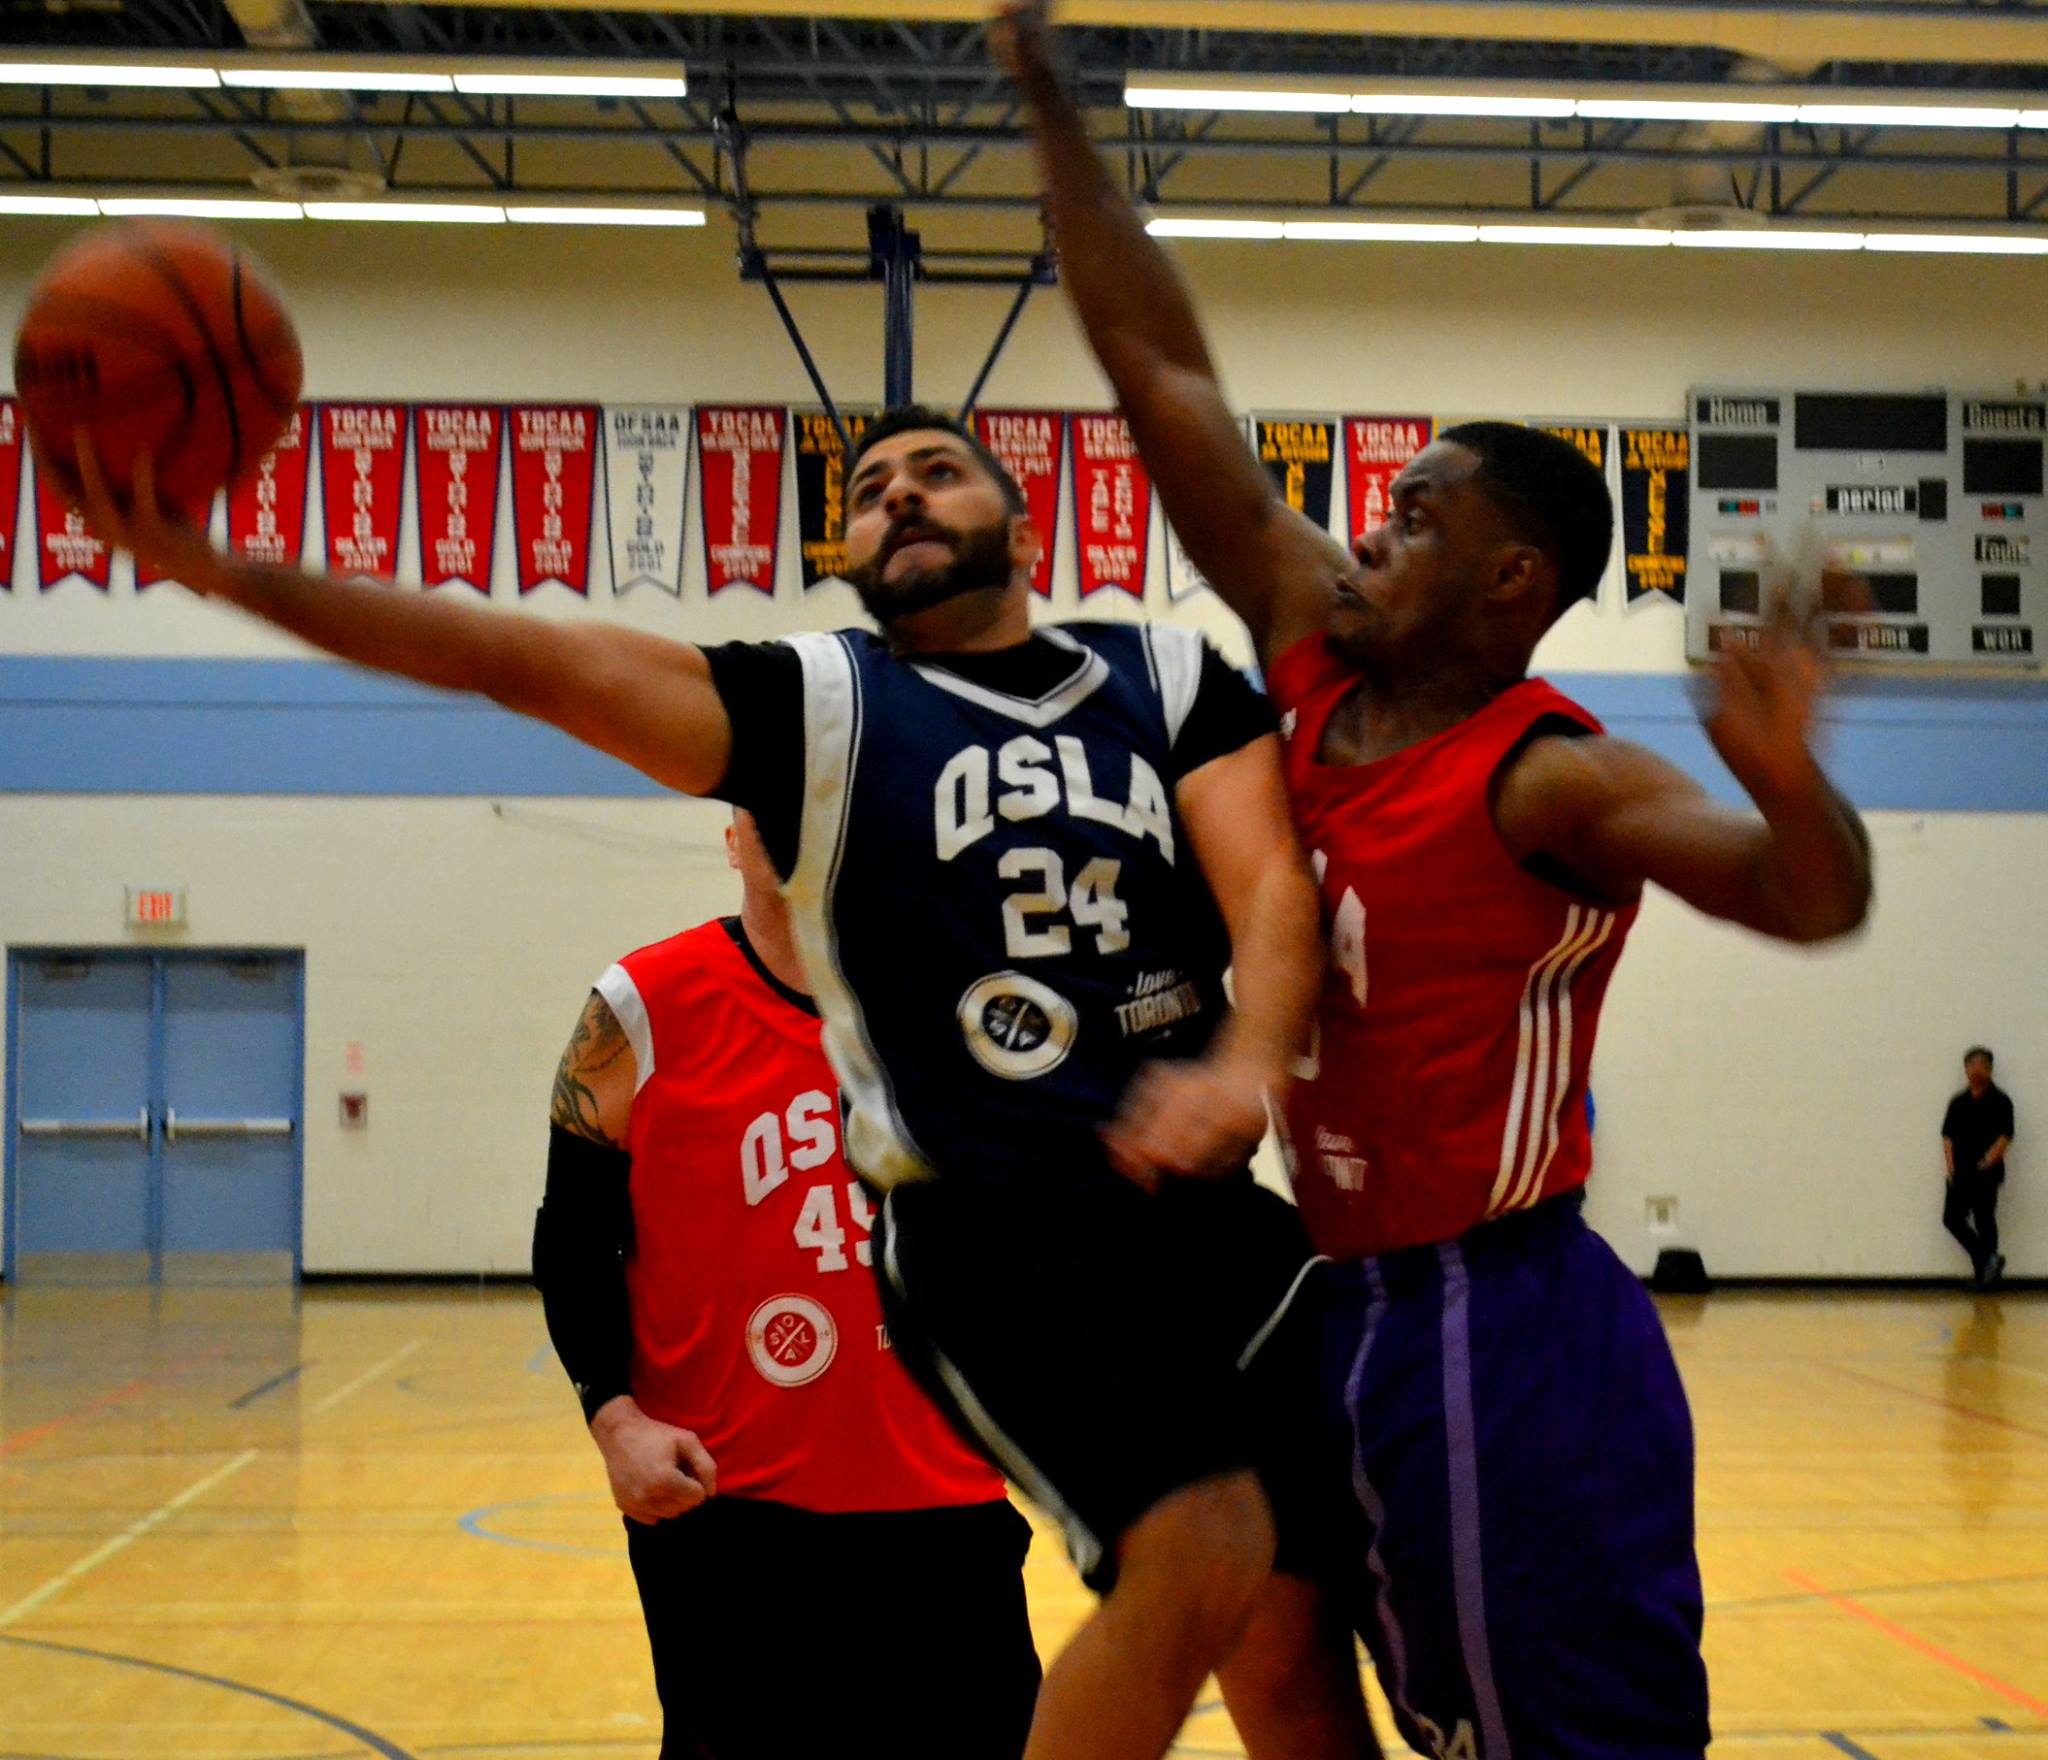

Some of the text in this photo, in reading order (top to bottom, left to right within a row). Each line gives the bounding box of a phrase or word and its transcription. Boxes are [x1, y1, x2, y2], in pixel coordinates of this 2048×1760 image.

[1837, 485, 1905, 517] period
[935, 735, 1175, 868] QSLA
[998, 846, 1131, 959] 24
[740, 1089, 837, 1207] QS
